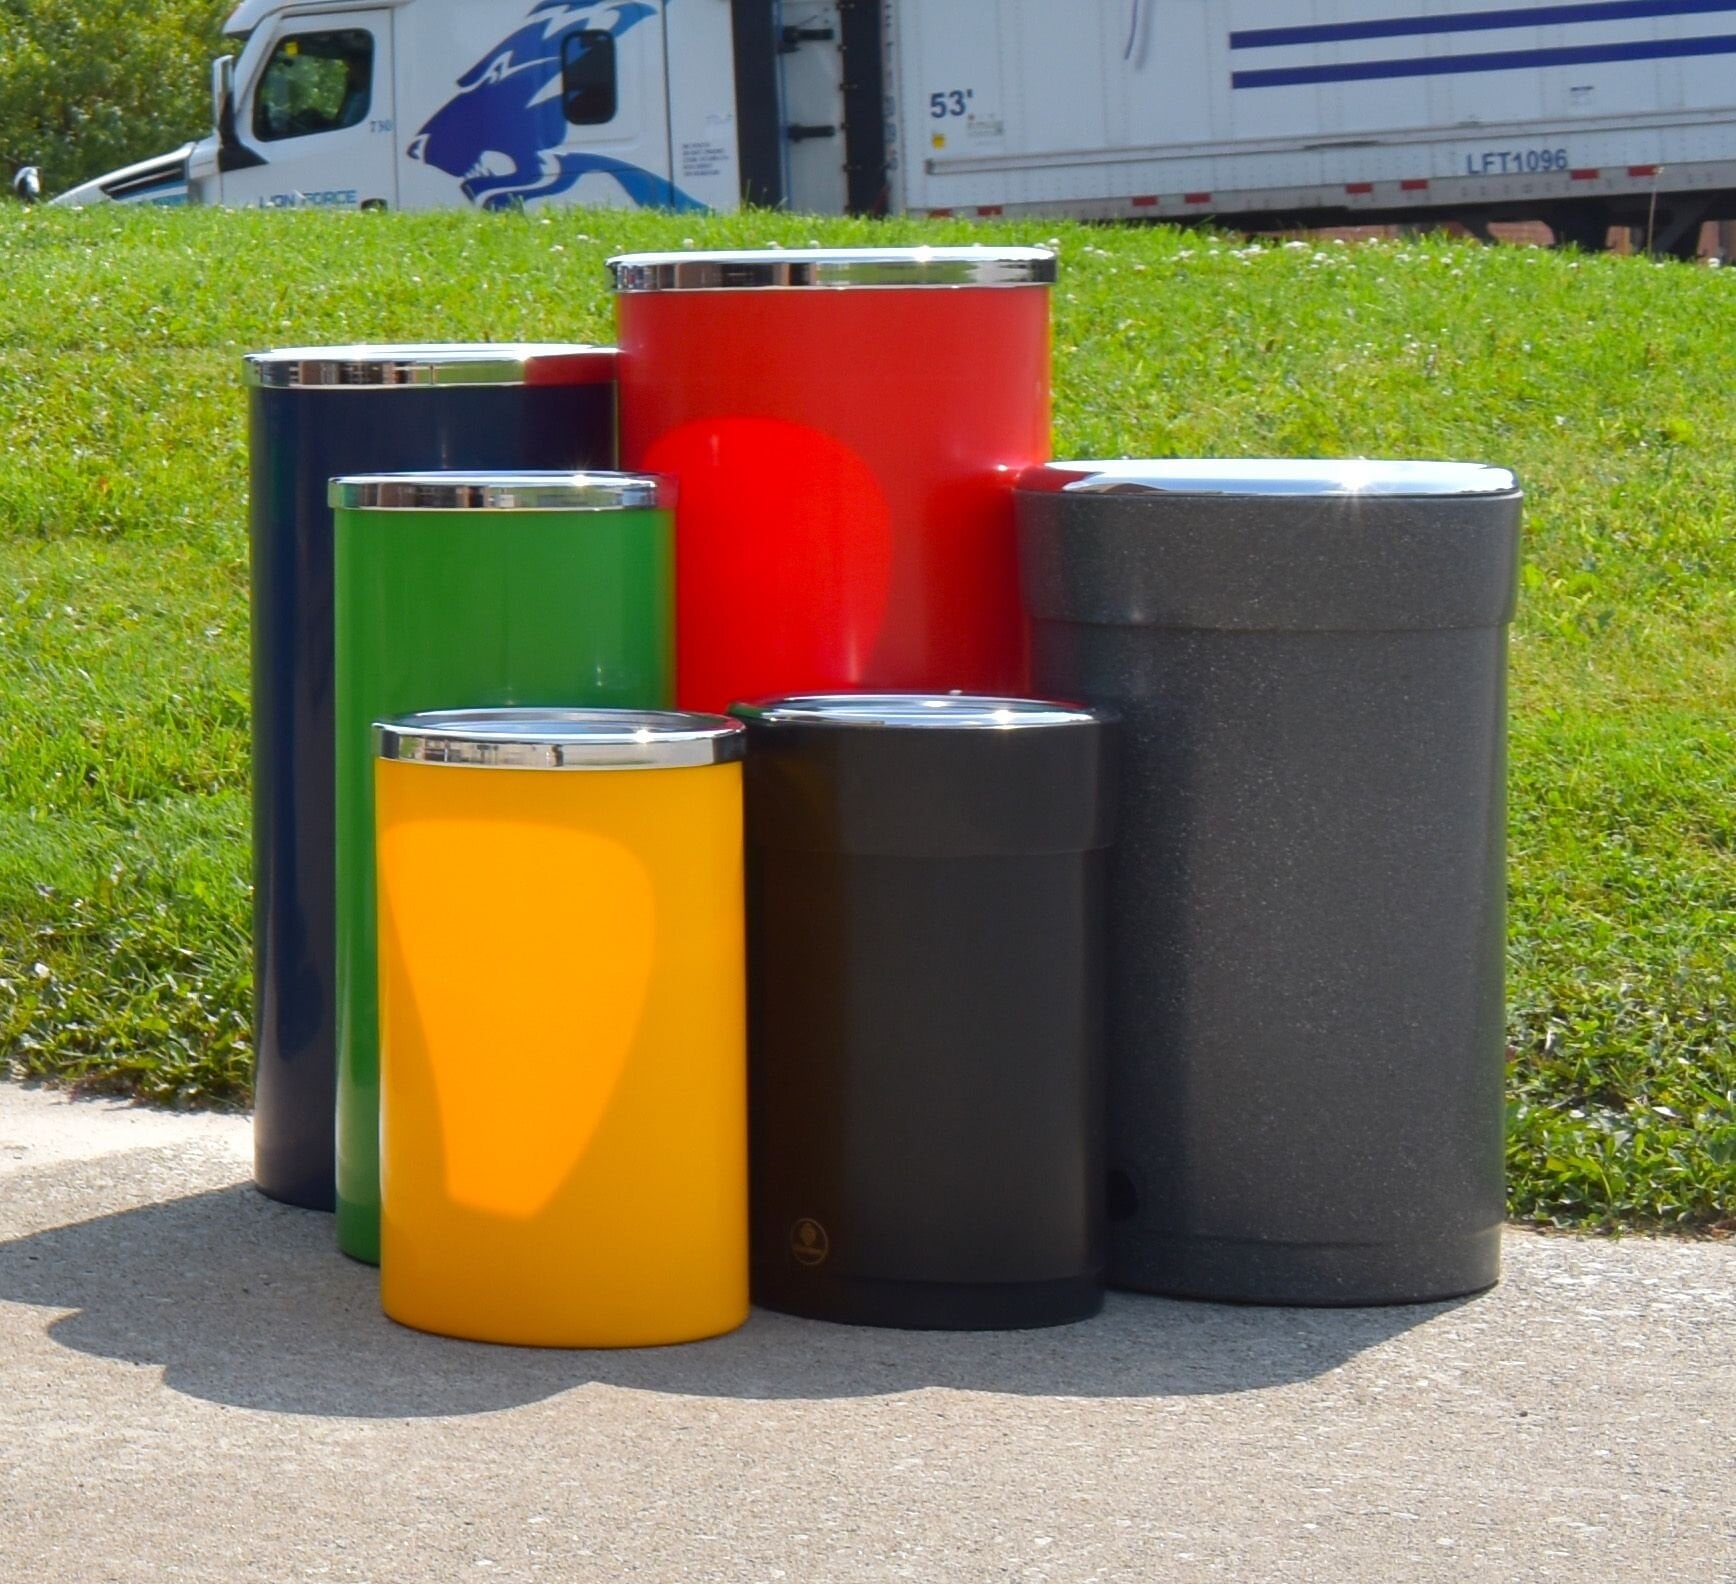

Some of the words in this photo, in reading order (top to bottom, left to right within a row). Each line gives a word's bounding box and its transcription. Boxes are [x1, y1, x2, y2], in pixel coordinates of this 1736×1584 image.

[930, 88, 973, 119] 53'
[1466, 148, 1568, 175] LFT1096
[301, 189, 357, 206] FORCE
